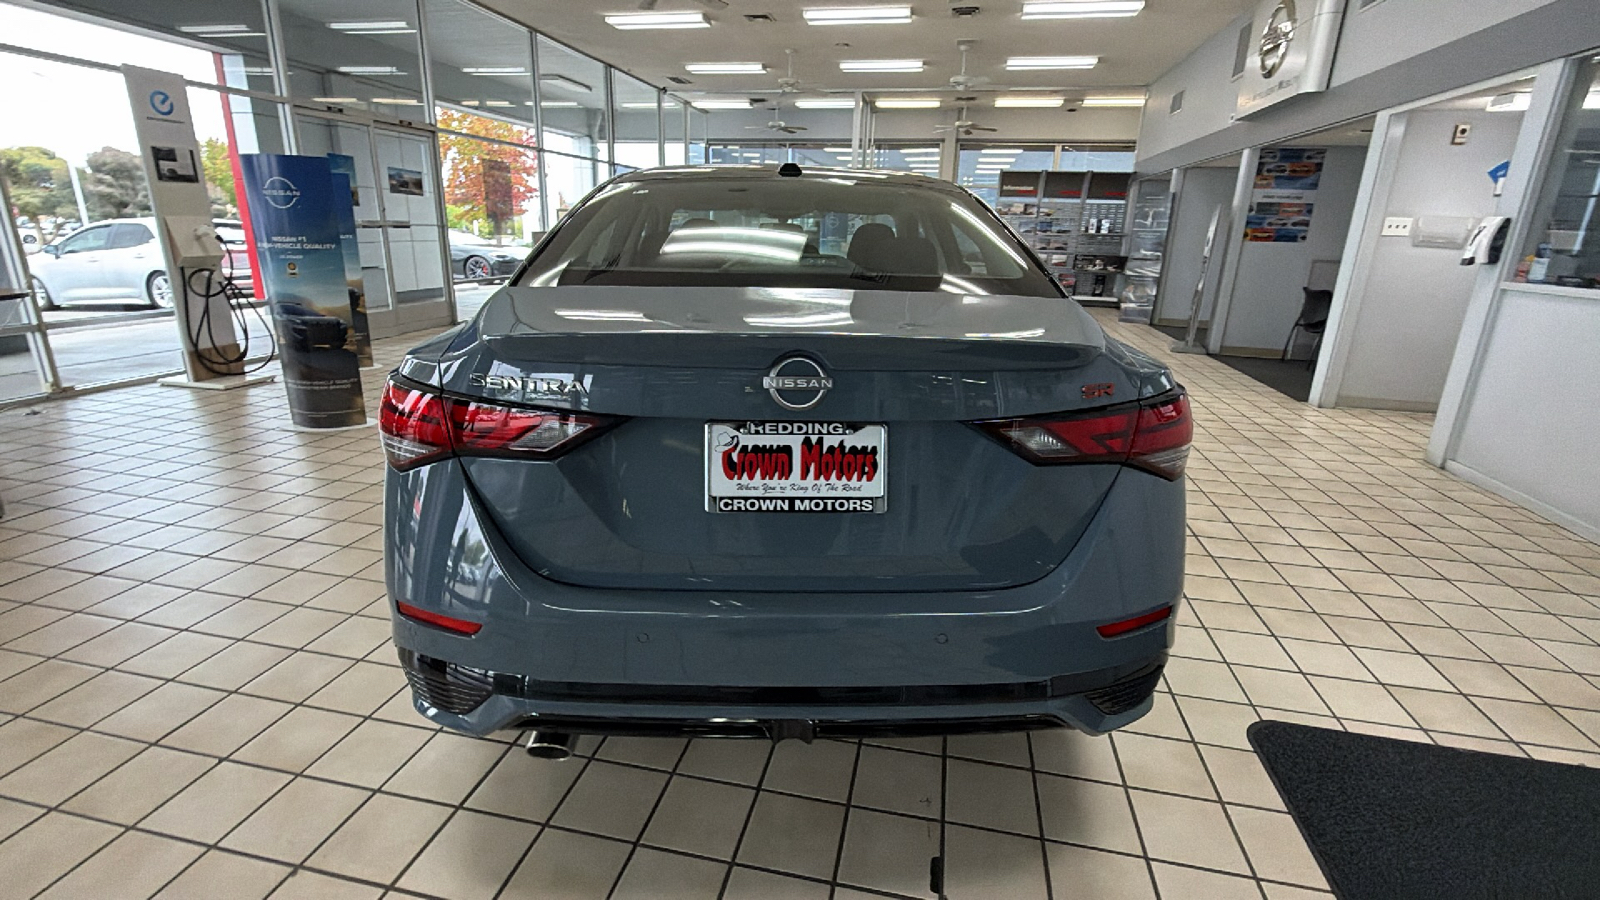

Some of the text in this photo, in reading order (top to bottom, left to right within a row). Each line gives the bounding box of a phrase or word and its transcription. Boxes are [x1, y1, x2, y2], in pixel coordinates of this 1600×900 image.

[469, 373, 590, 395] SENTRA
[765, 378, 833, 389] NISSAN
[1081, 382, 1115, 399] SR
[750, 422, 844, 435] REDDING
[721, 436, 878, 482] Crown Motors
[736, 483, 862, 495] Where You're King Of The Road
[719, 499, 873, 511] CROWN MOTORS
